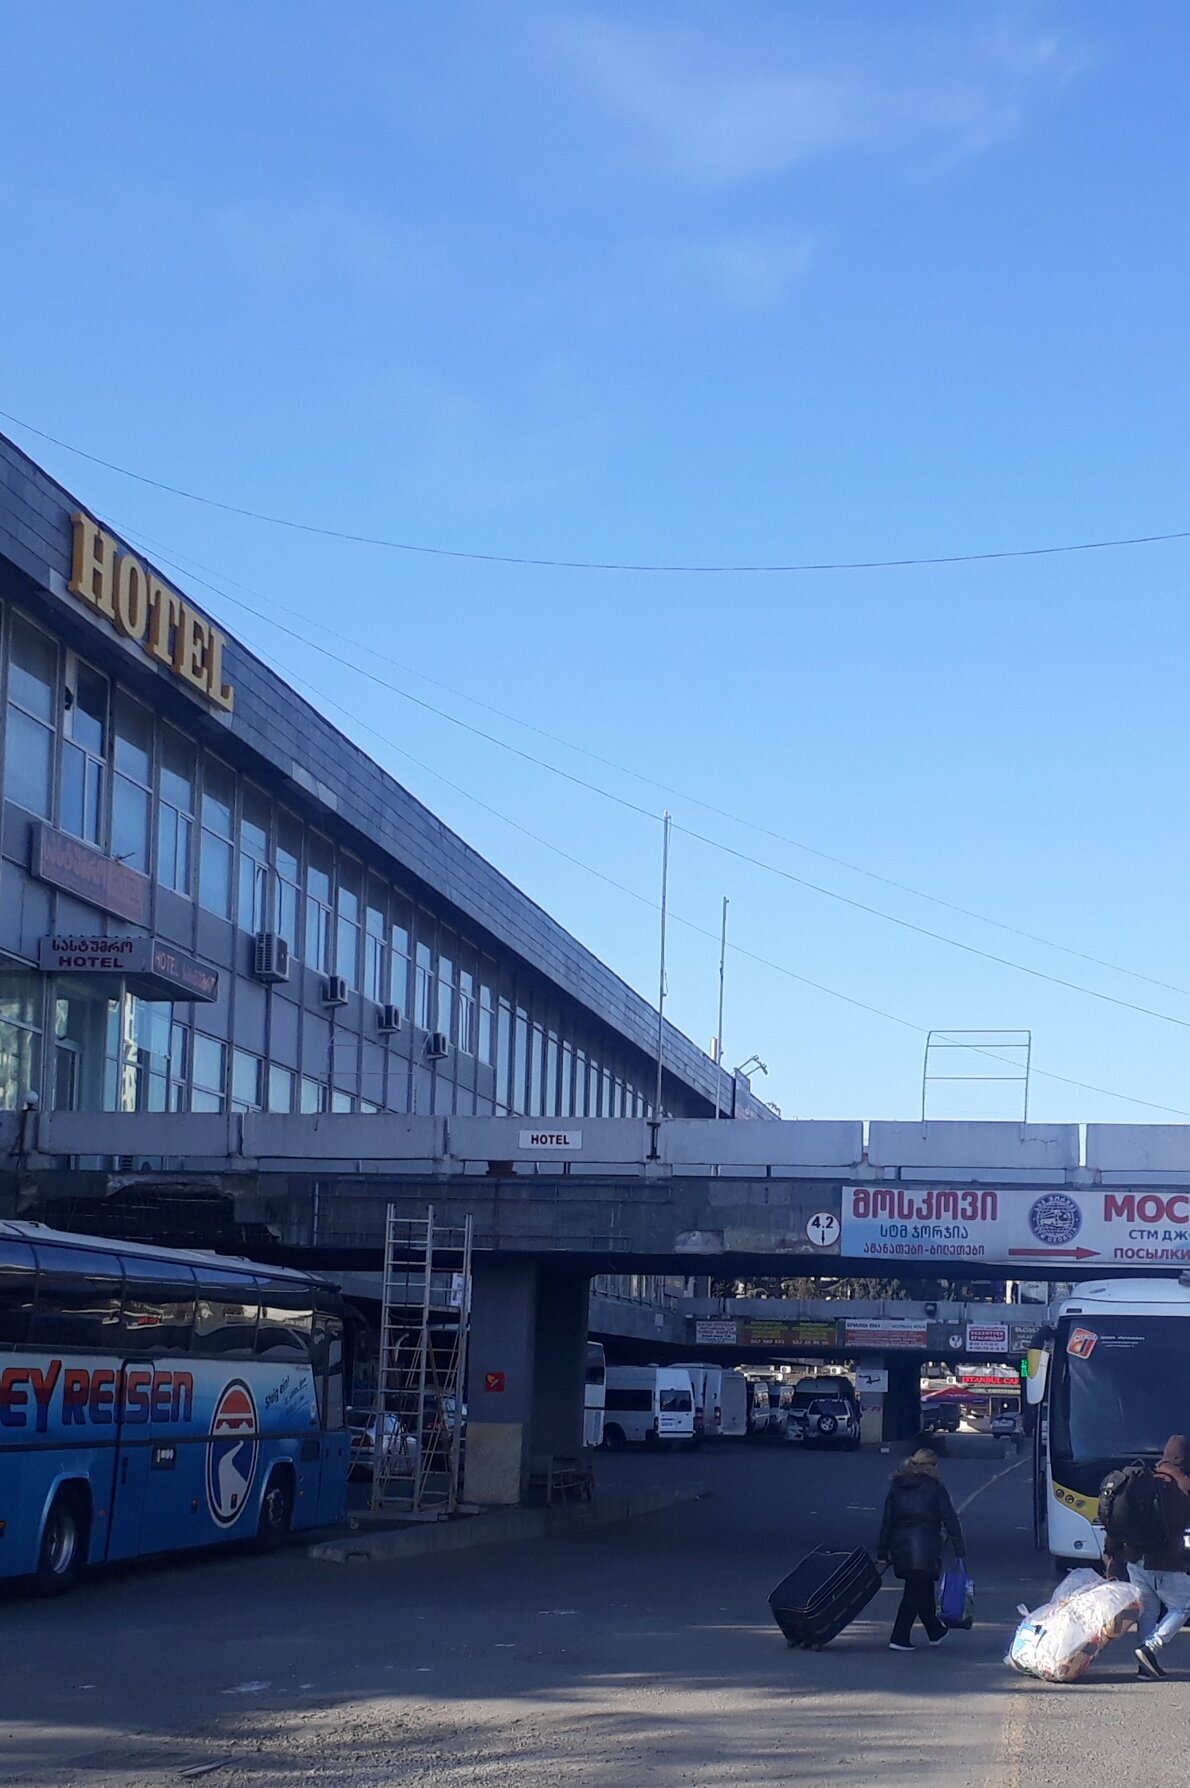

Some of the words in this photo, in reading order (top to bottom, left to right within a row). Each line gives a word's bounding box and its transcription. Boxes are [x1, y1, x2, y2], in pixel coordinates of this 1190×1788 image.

[68, 512, 233, 713] HOTEL
[52, 939, 133, 952] სასტუმრო
[58, 956, 124, 968] HOTEL
[530, 1133, 570, 1145] HOTEL
[852, 1189, 998, 1221] მოსკოვი
[811, 1216, 834, 1229] 4.2
[880, 1224, 907, 1238] სტმ
[912, 1225, 969, 1239] ჯორჯია
[1128, 1229, 1158, 1241] СТМ
